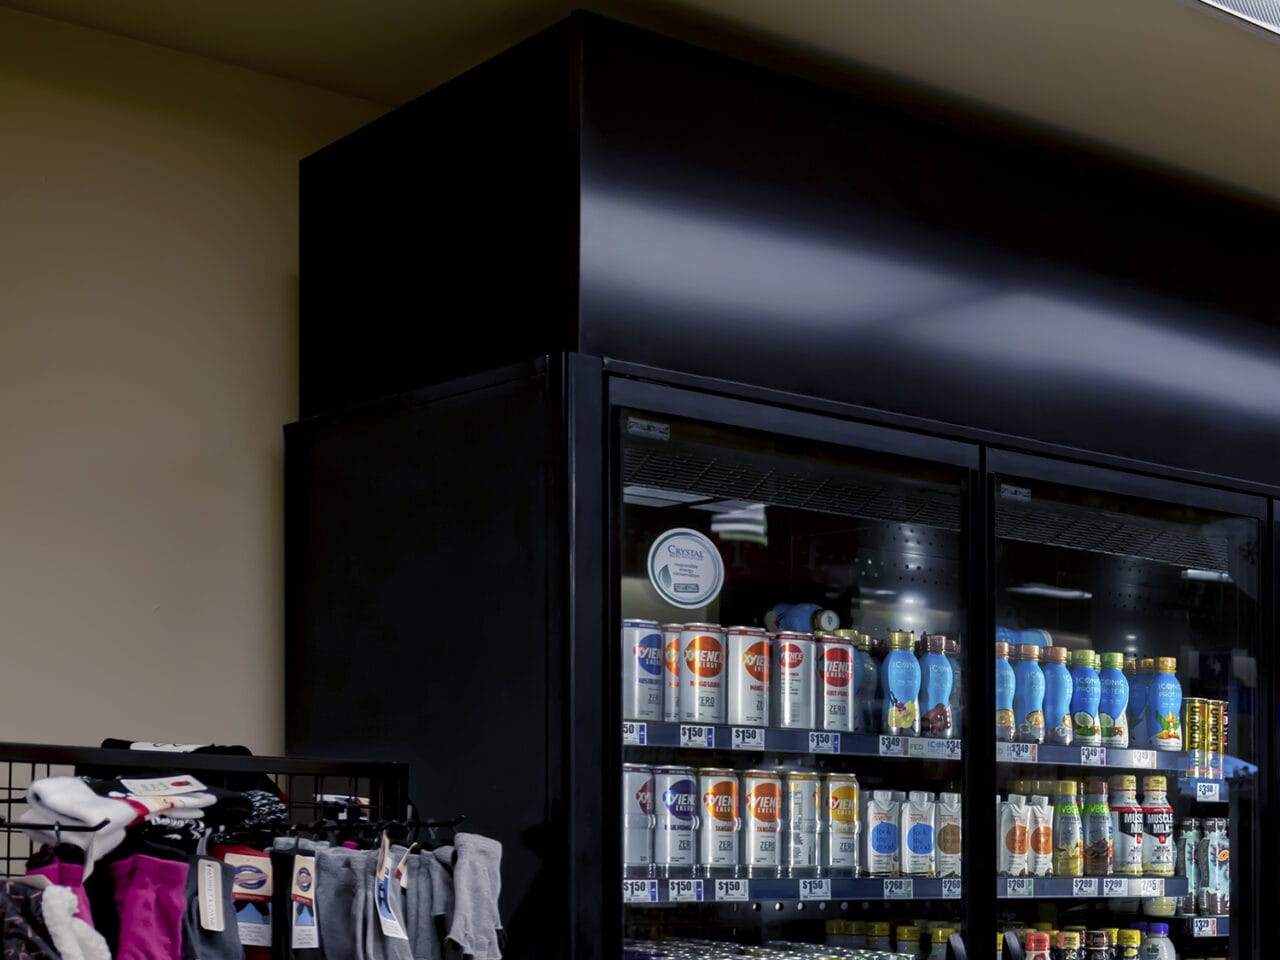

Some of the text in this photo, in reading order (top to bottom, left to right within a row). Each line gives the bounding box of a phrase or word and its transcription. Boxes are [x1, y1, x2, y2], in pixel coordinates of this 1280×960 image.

[667, 544, 704, 558] CRYSTAL
[682, 727, 703, 742] $150
[735, 730, 756, 744] $150
[810, 735, 829, 748] $150
[881, 738, 900, 752] $349
[1012, 747, 1029, 761] $349
[1081, 747, 1098, 761] $349
[1147, 813, 1173, 825] MUSCLE
[1153, 824, 1171, 835] MILK
[624, 880, 647, 895] $150
[672, 880, 693, 895] $150
[719, 880, 741, 895] $150
[803, 880, 824, 894] $150
